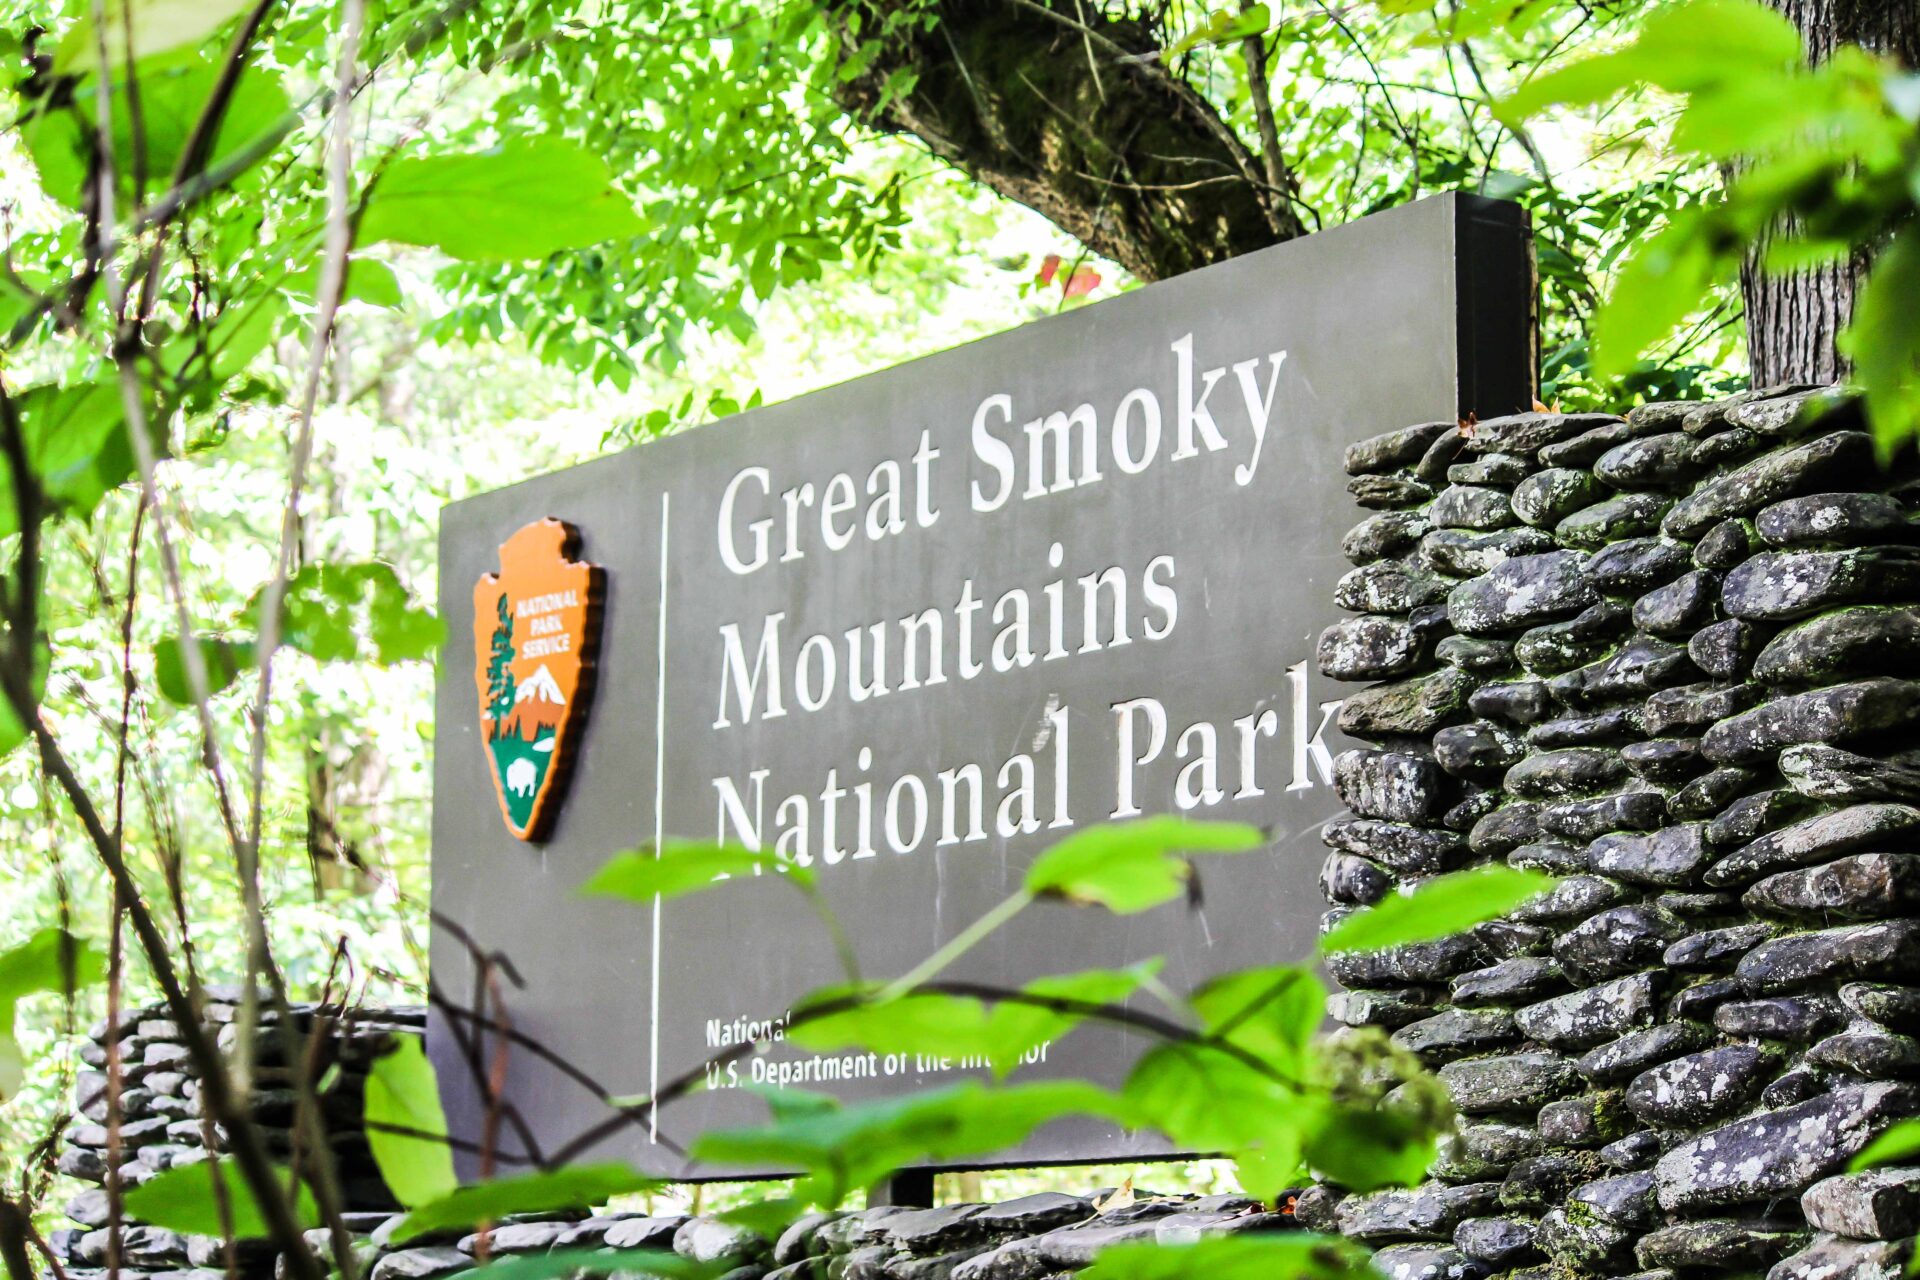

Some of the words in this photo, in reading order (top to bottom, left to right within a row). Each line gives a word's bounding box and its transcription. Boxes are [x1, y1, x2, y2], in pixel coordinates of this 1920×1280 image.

[717, 428, 940, 575] Great
[971, 332, 1288, 513] Smoky
[516, 589, 578, 618] NATIONAL
[530, 614, 563, 636] PARK
[712, 542, 1178, 729] Mountains
[522, 633, 570, 659] SERVICE
[712, 705, 1074, 878] National
[1110, 659, 1343, 818] Park
[706, 1060, 743, 1090] U.S.
[752, 1053, 877, 1089] Department
[884, 1053, 907, 1075] of
